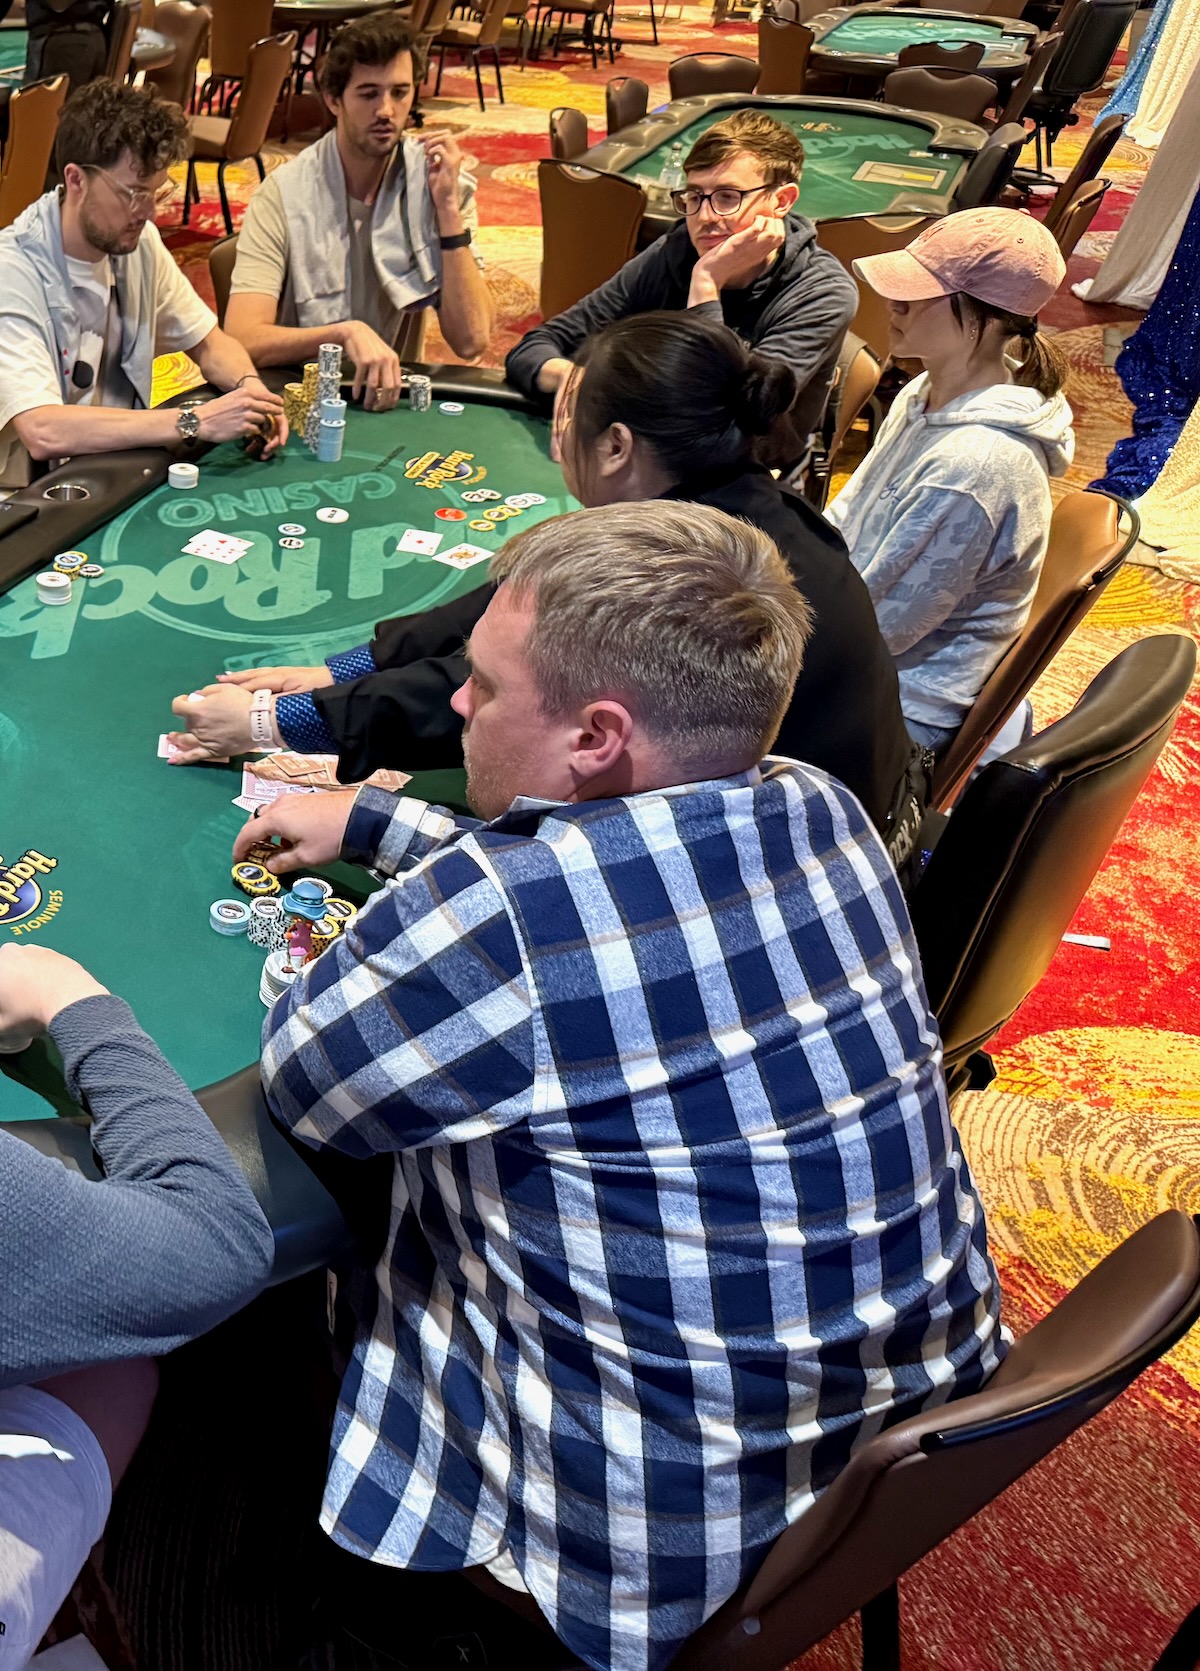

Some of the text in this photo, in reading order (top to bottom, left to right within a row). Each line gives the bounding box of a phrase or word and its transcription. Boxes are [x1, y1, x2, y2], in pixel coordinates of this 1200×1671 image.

[414, 467, 457, 489] Rock
[438, 449, 475, 472] Hard
[158, 472, 397, 527] CASINO
[9, 889, 64, 936] SEMINOLE
